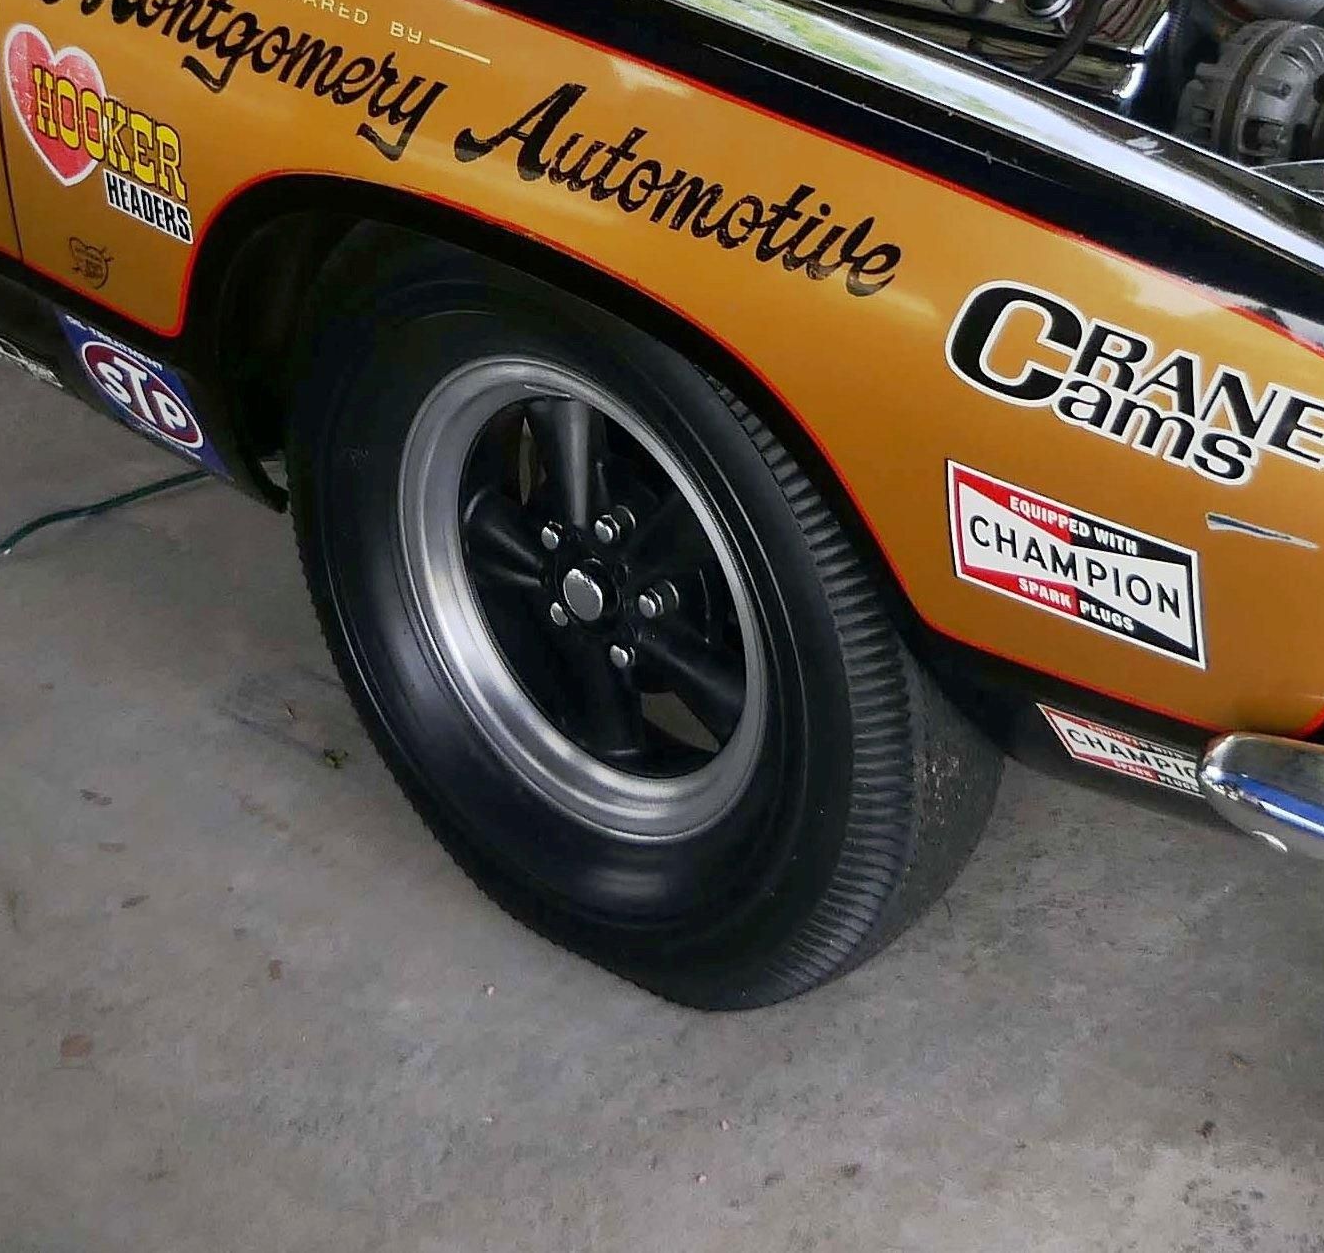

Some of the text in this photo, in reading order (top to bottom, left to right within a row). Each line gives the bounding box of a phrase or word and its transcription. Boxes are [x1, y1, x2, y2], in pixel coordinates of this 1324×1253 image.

[389, 20, 424, 44] BY
[32, 63, 187, 202] HOOKER
[105, 171, 192, 242] HEADERS
[453, 82, 903, 297] Automotive
[97, 356, 188, 431] STP
[1009, 495, 1138, 556] EQUIPPED WITH
[968, 513, 1182, 620] CHAMPION
[1017, 577, 1136, 632] SPARK PLUGS
